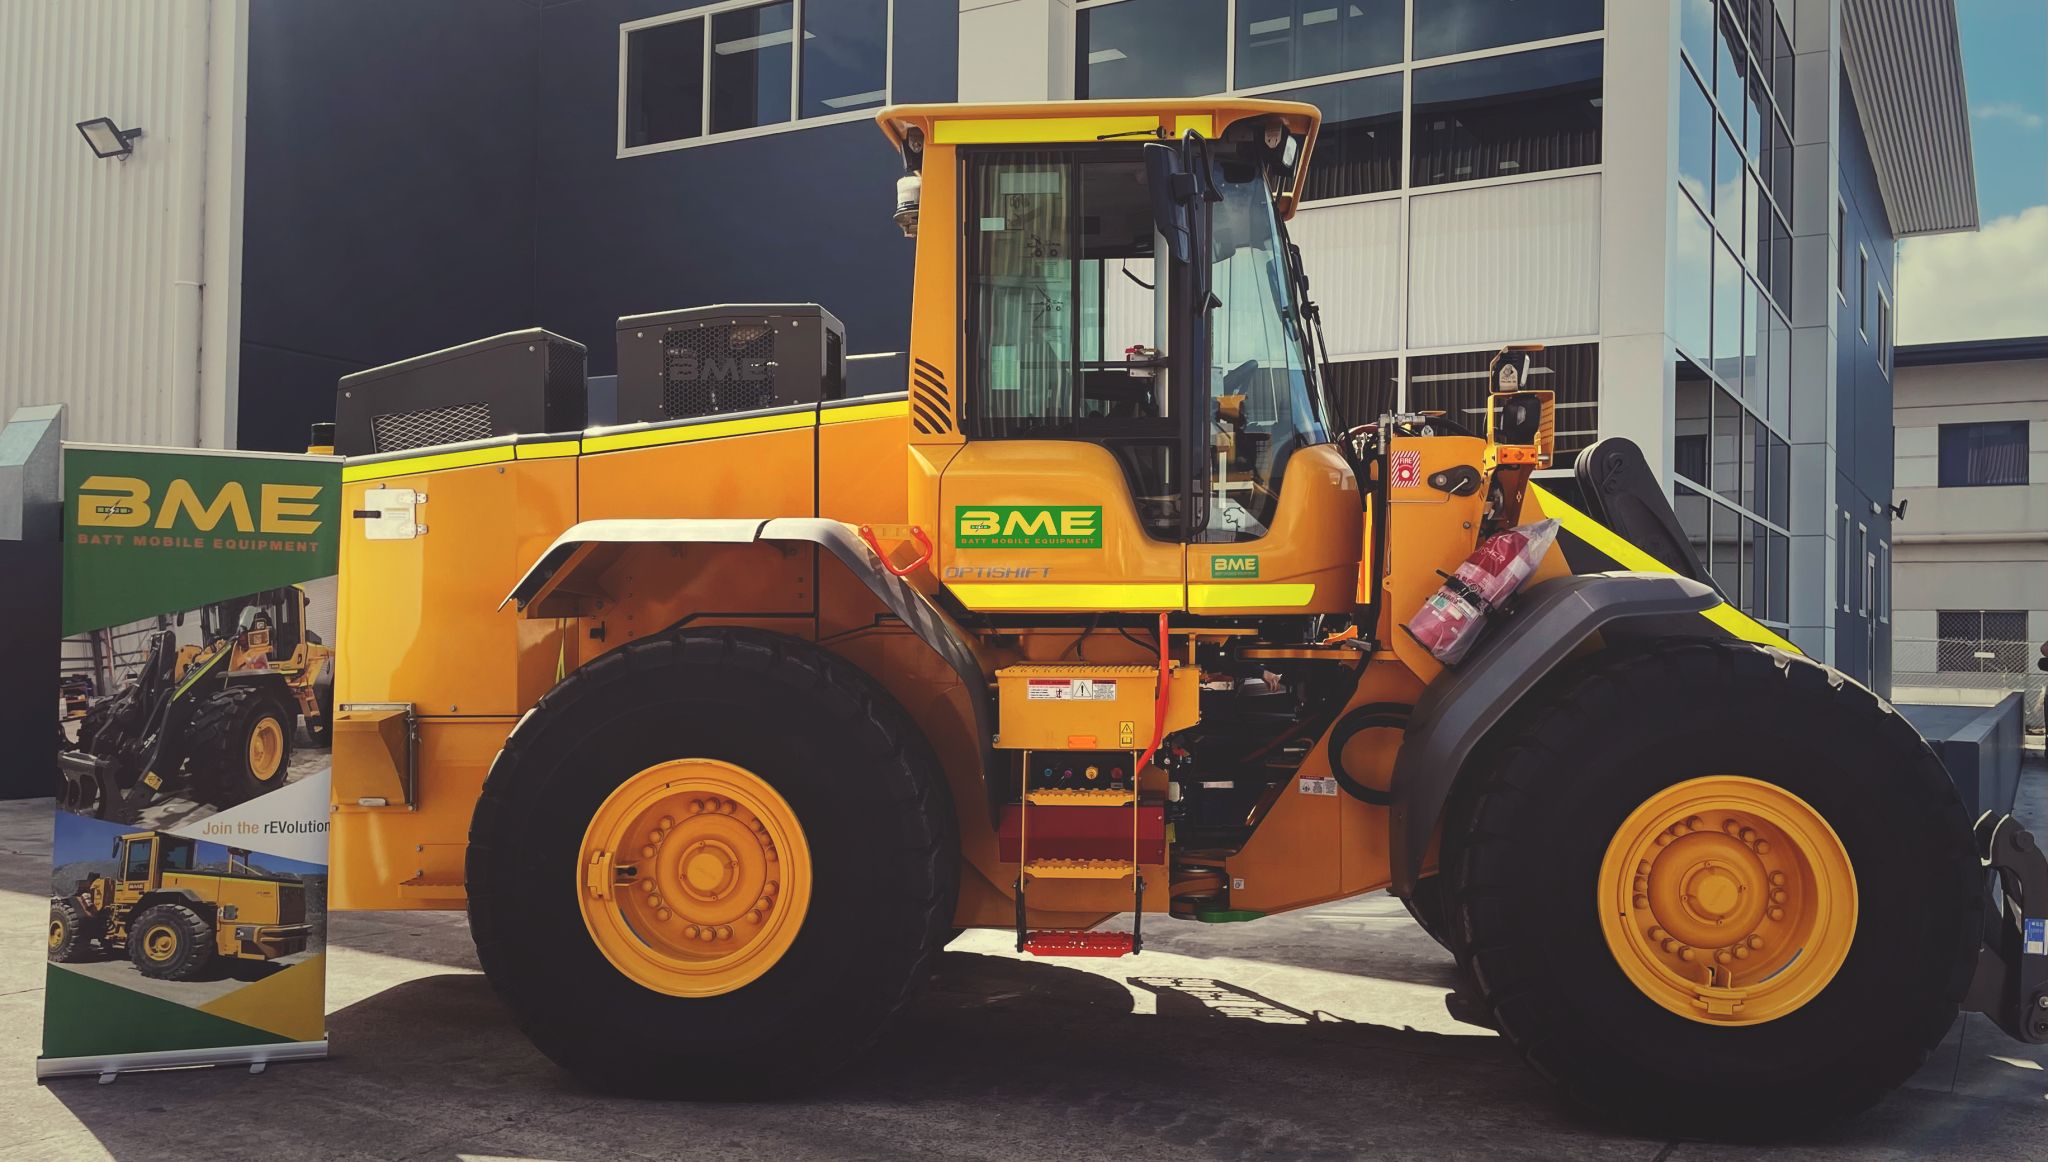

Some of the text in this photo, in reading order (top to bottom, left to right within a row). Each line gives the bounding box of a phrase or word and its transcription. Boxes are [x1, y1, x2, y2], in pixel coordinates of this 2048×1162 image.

[669, 358, 770, 381] BME
[78, 475, 324, 535] BME
[960, 511, 1097, 536] BME
[78, 534, 319, 553] BATT MOBILE EQUIPMENT
[944, 566, 1054, 579] OPTISHIFT
[1214, 558, 1257, 571] BME
[203, 820, 331, 835] Join the rEVolution
